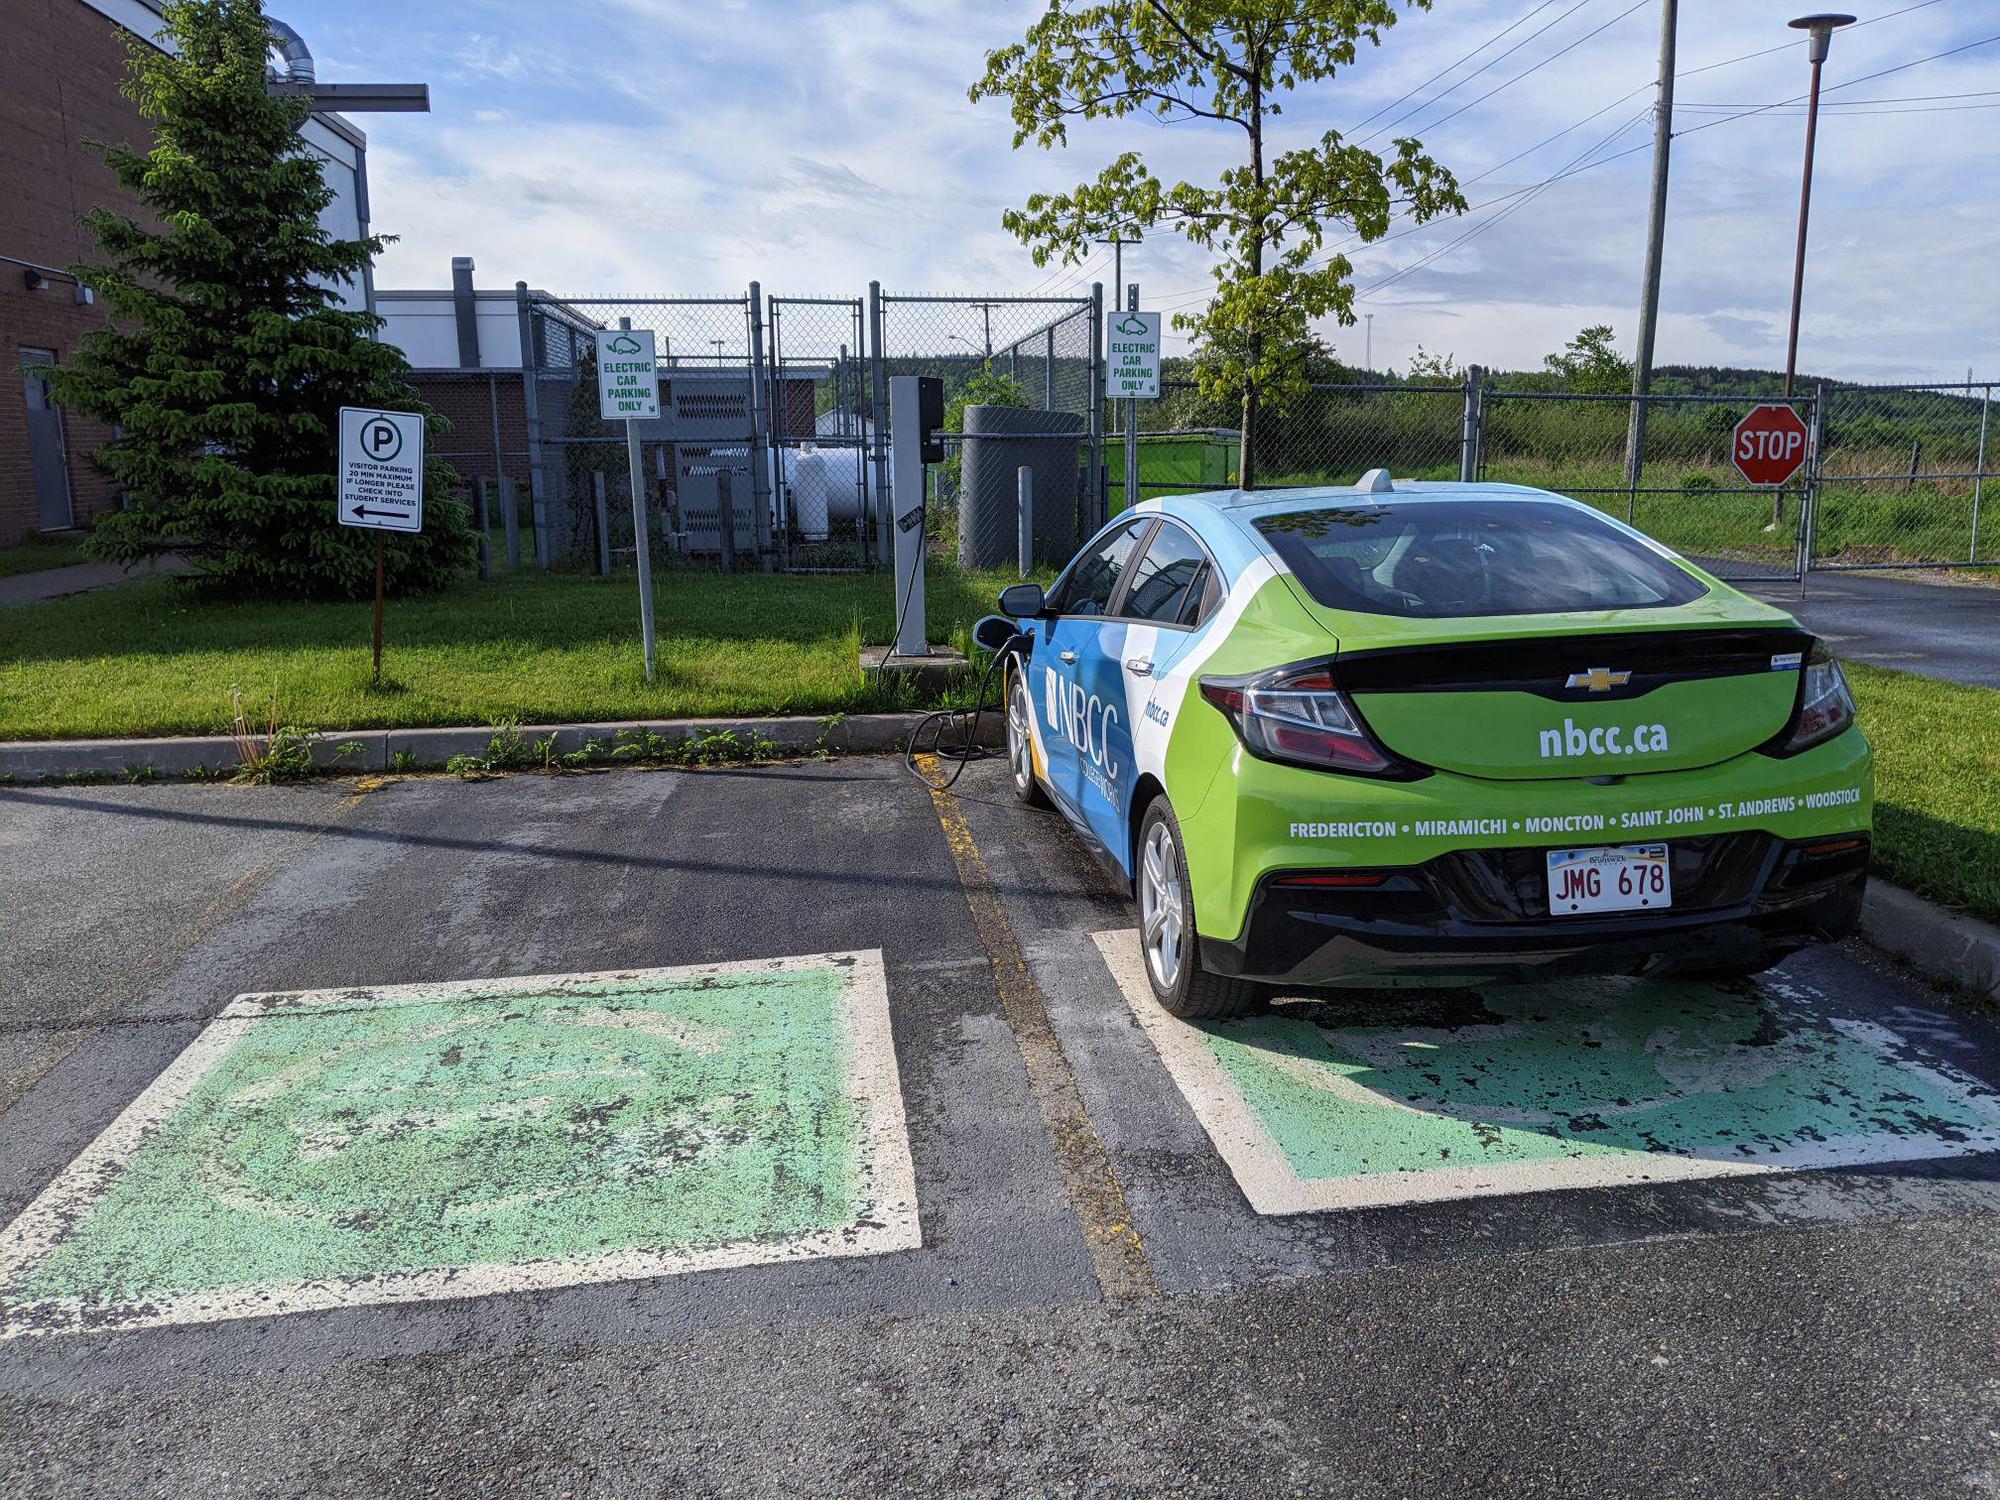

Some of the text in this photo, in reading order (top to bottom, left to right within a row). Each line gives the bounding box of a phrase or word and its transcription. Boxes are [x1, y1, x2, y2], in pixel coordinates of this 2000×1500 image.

[1112, 343, 1155, 353] ELECTRIC
[1122, 356, 1141, 365] CAR
[603, 362, 651, 372] ELECTRIC
[1114, 368, 1152, 378] PARKING
[617, 375, 637, 385] CAR
[1121, 380, 1144, 390] ONLY
[608, 388, 651, 398] PARKING
[618, 401, 642, 411] ONLY
[374, 426, 393, 452] P
[1738, 430, 1802, 460] STOP
[349, 462, 413, 473] VISITOR PARKING
[376, 473, 412, 481] MAXIMUM
[355, 479, 385, 487] LONGER
[387, 481, 415, 490] PLEASE
[358, 487, 403, 497] CHECK INTO
[345, 494, 416, 506] STUDENT SERVICES
[1145, 697, 1169, 727] nbcc.ca
[1059, 674, 1118, 779] NBCC
[1539, 718, 1668, 758] nbcc.ca
[1290, 787, 1861, 838] FREDERICTON MIRAMICHI MONCTON SAINT JOHN ST. ANDREWS WOODSTOCK
[1556, 864, 1665, 900] JMG 678
